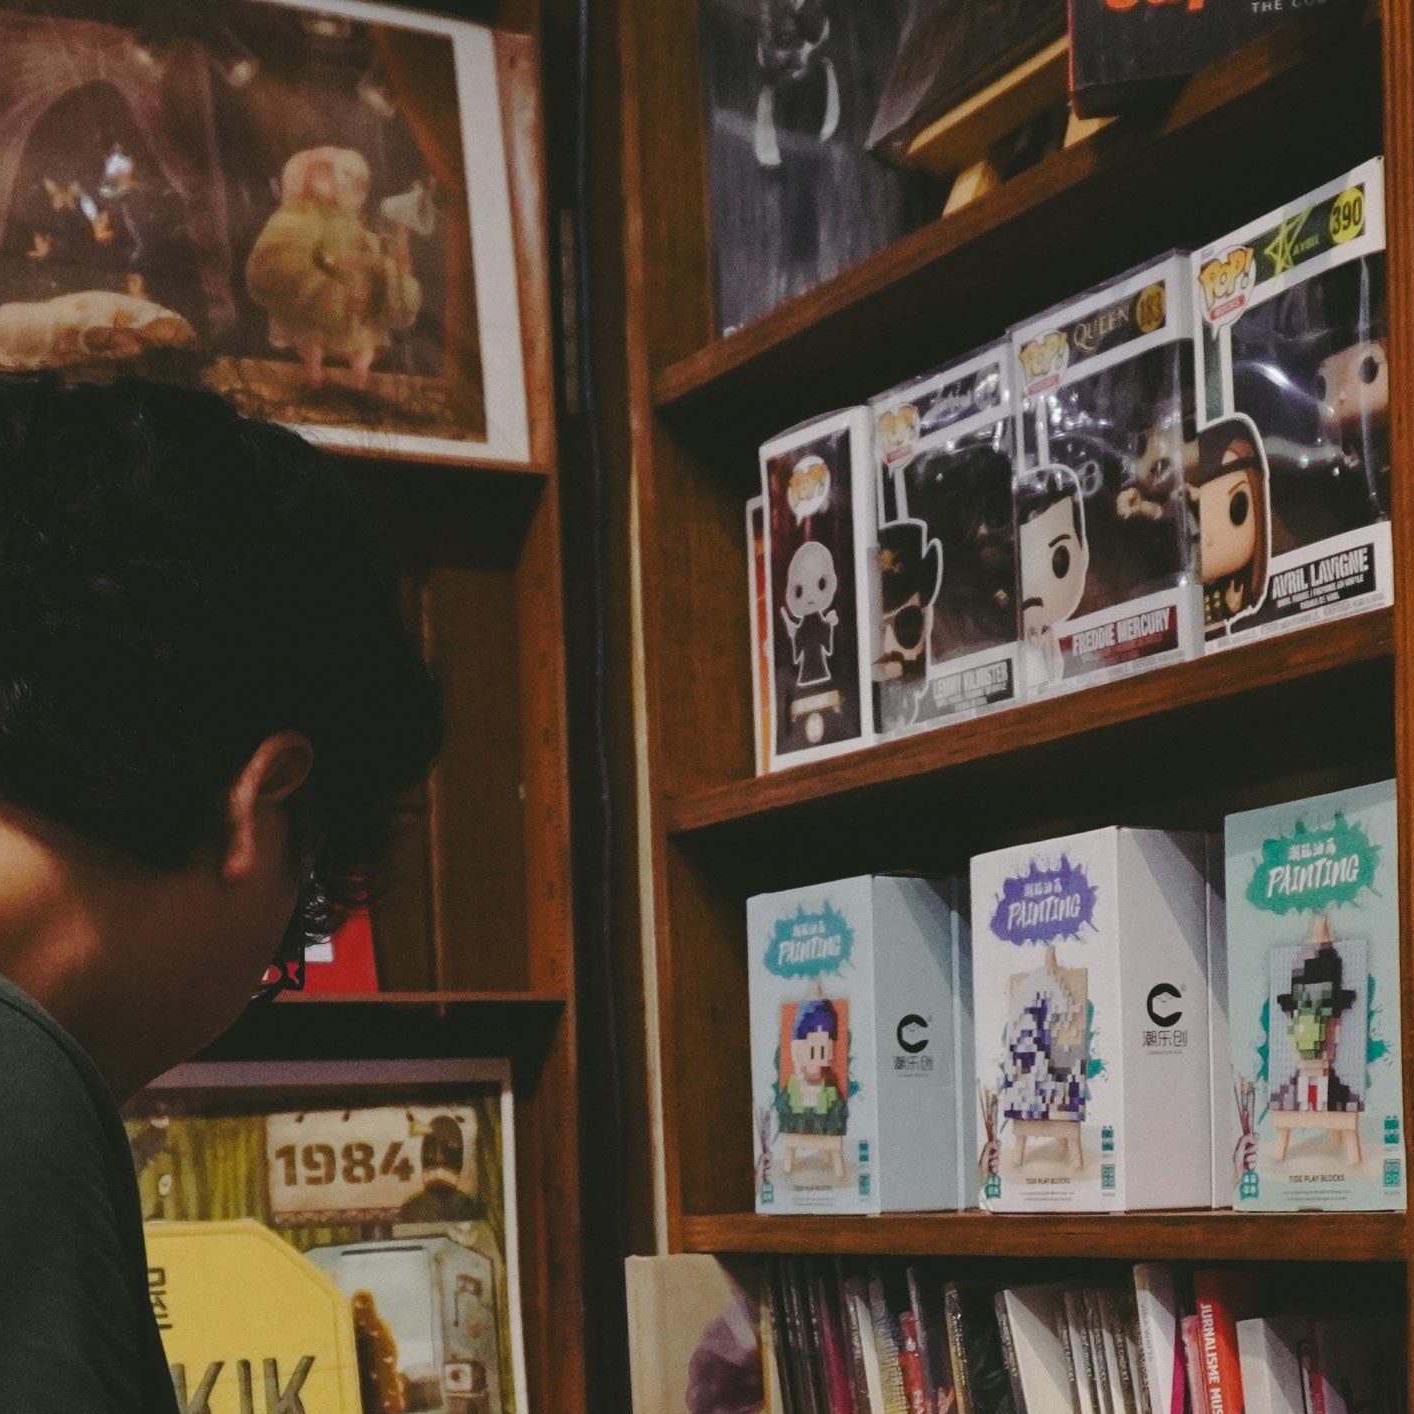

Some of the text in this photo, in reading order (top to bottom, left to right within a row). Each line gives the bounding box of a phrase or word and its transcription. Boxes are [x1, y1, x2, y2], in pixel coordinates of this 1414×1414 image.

[1330, 198, 1364, 237] 390
[1072, 306, 1132, 351] QUEEN
[1072, 607, 1172, 655] FREDDIE MERCURY
[1267, 854, 1360, 899] PAINTING
[1007, 893, 1082, 931] PAINTING
[274, 1141, 414, 1188] 1984
[1199, 1302, 1221, 1387] JURNALISME
